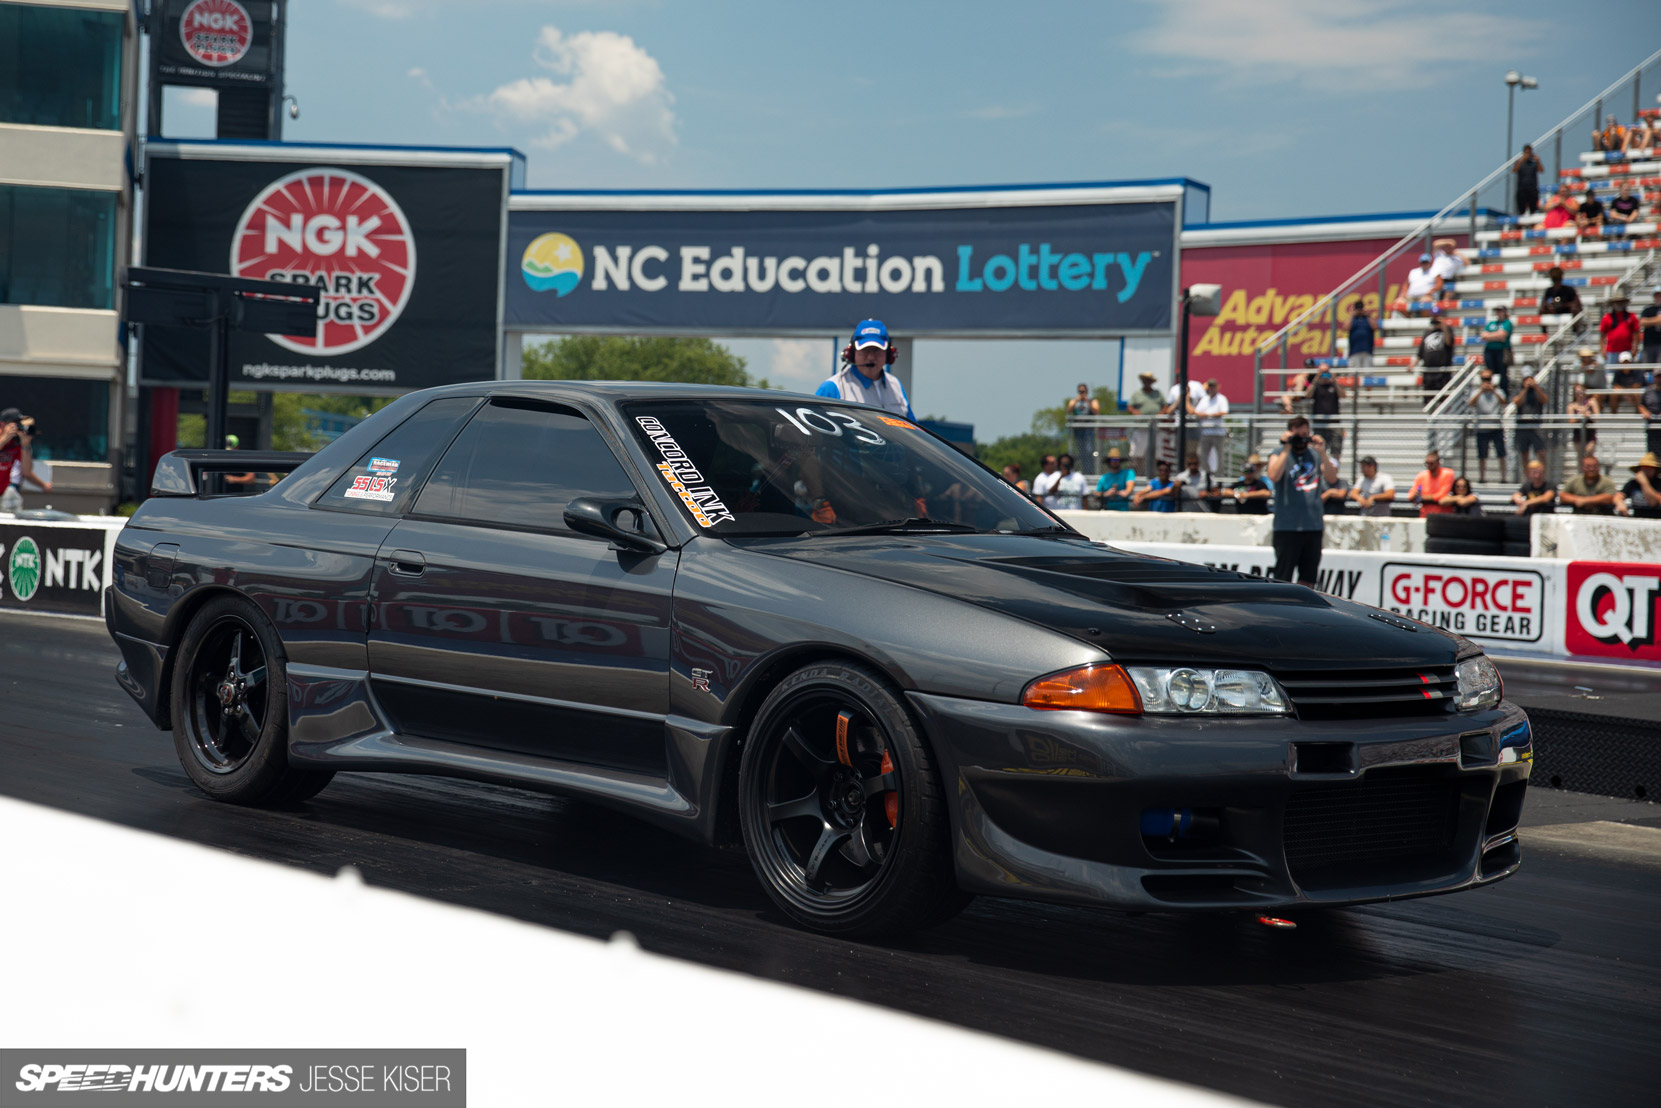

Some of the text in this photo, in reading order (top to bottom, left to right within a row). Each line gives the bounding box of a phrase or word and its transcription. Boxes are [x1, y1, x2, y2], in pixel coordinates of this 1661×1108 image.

[193, 11, 239, 31] NGK
[264, 213, 383, 260] NGK
[591, 242, 1152, 304] NC Education Lottery
[242, 362, 396, 382] ngksparkplugs.com
[775, 407, 886, 446] 103
[635, 416, 736, 526] CONCORD INK
[15, 553, 36, 569] NTK
[44, 547, 103, 593] NTK
[1391, 573, 1533, 614] G-FORCE
[1576, 572, 1661, 645] QT
[1476, 613, 1531, 636] GEAR
